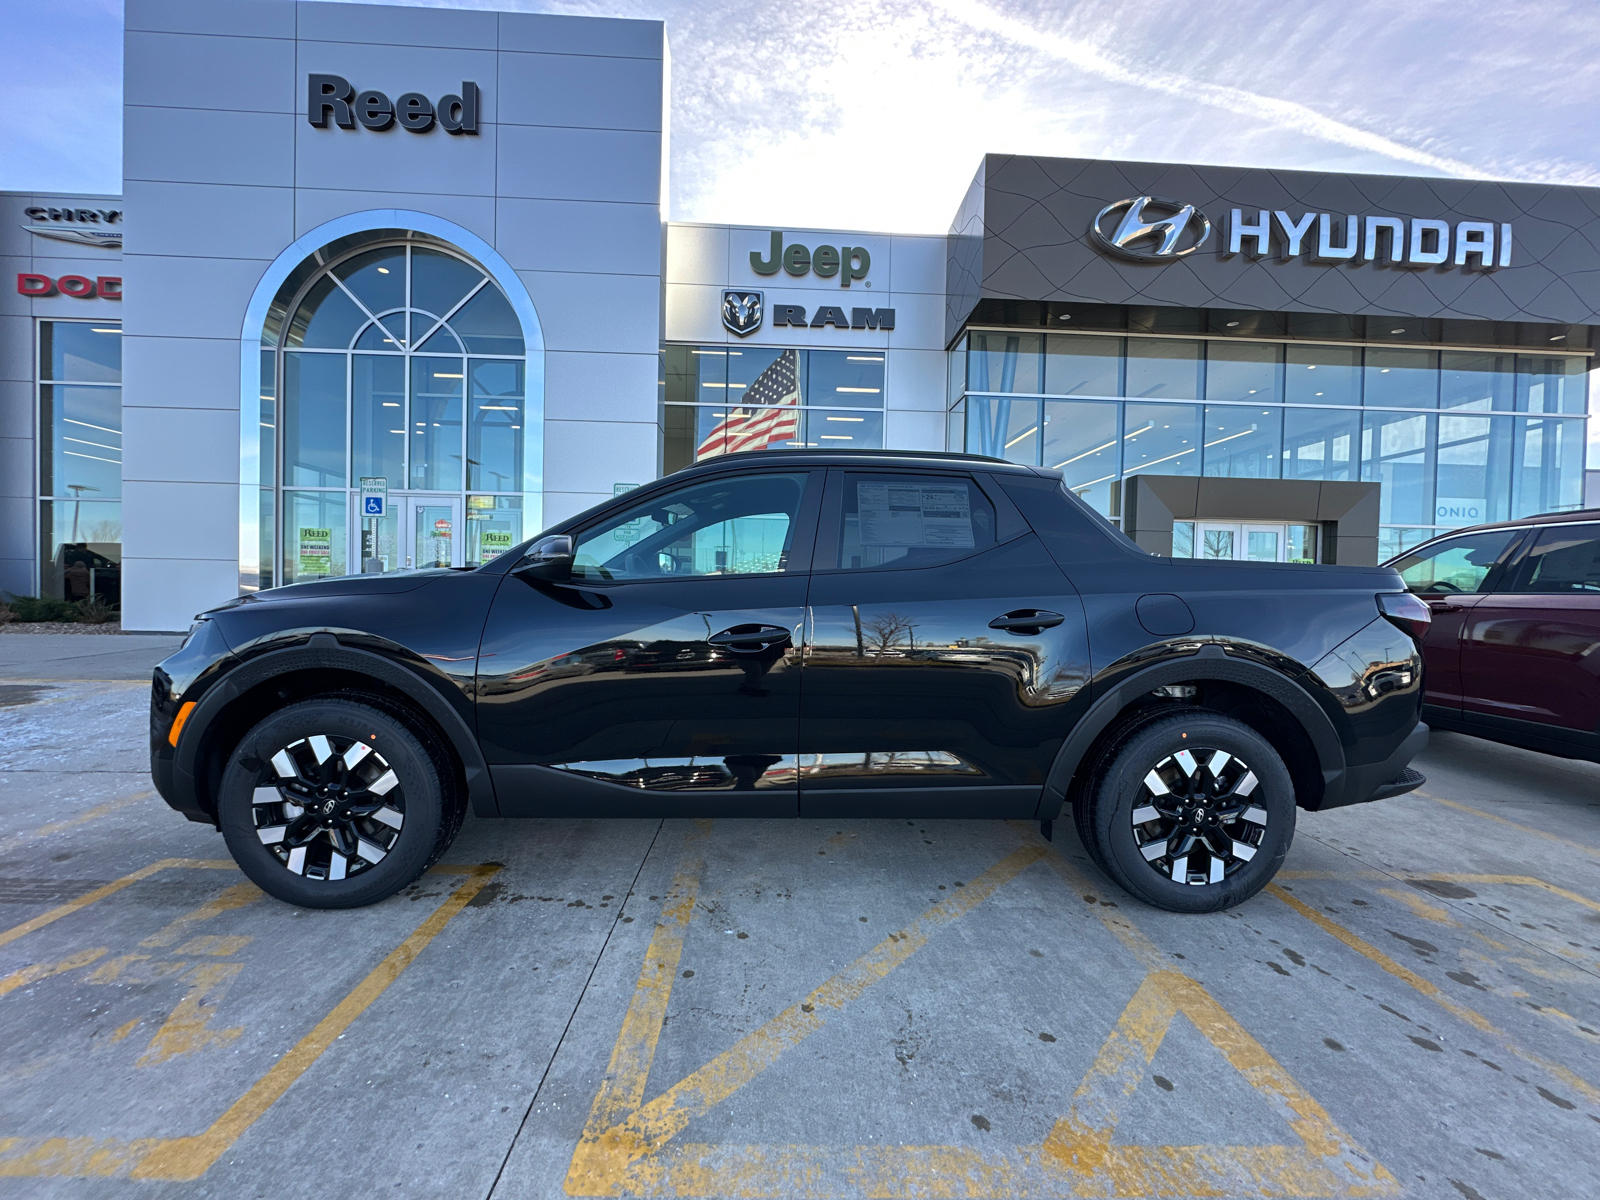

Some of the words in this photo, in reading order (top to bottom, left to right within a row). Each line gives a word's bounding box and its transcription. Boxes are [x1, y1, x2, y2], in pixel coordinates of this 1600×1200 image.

[308, 73, 479, 136] Reed
[24, 206, 122, 223] CHRY
[1224, 207, 1512, 271] HYUNDAI
[749, 230, 871, 288] Jeep
[773, 303, 896, 331] RAM
[304, 529, 328, 538] REED
[485, 533, 510, 542] REED
